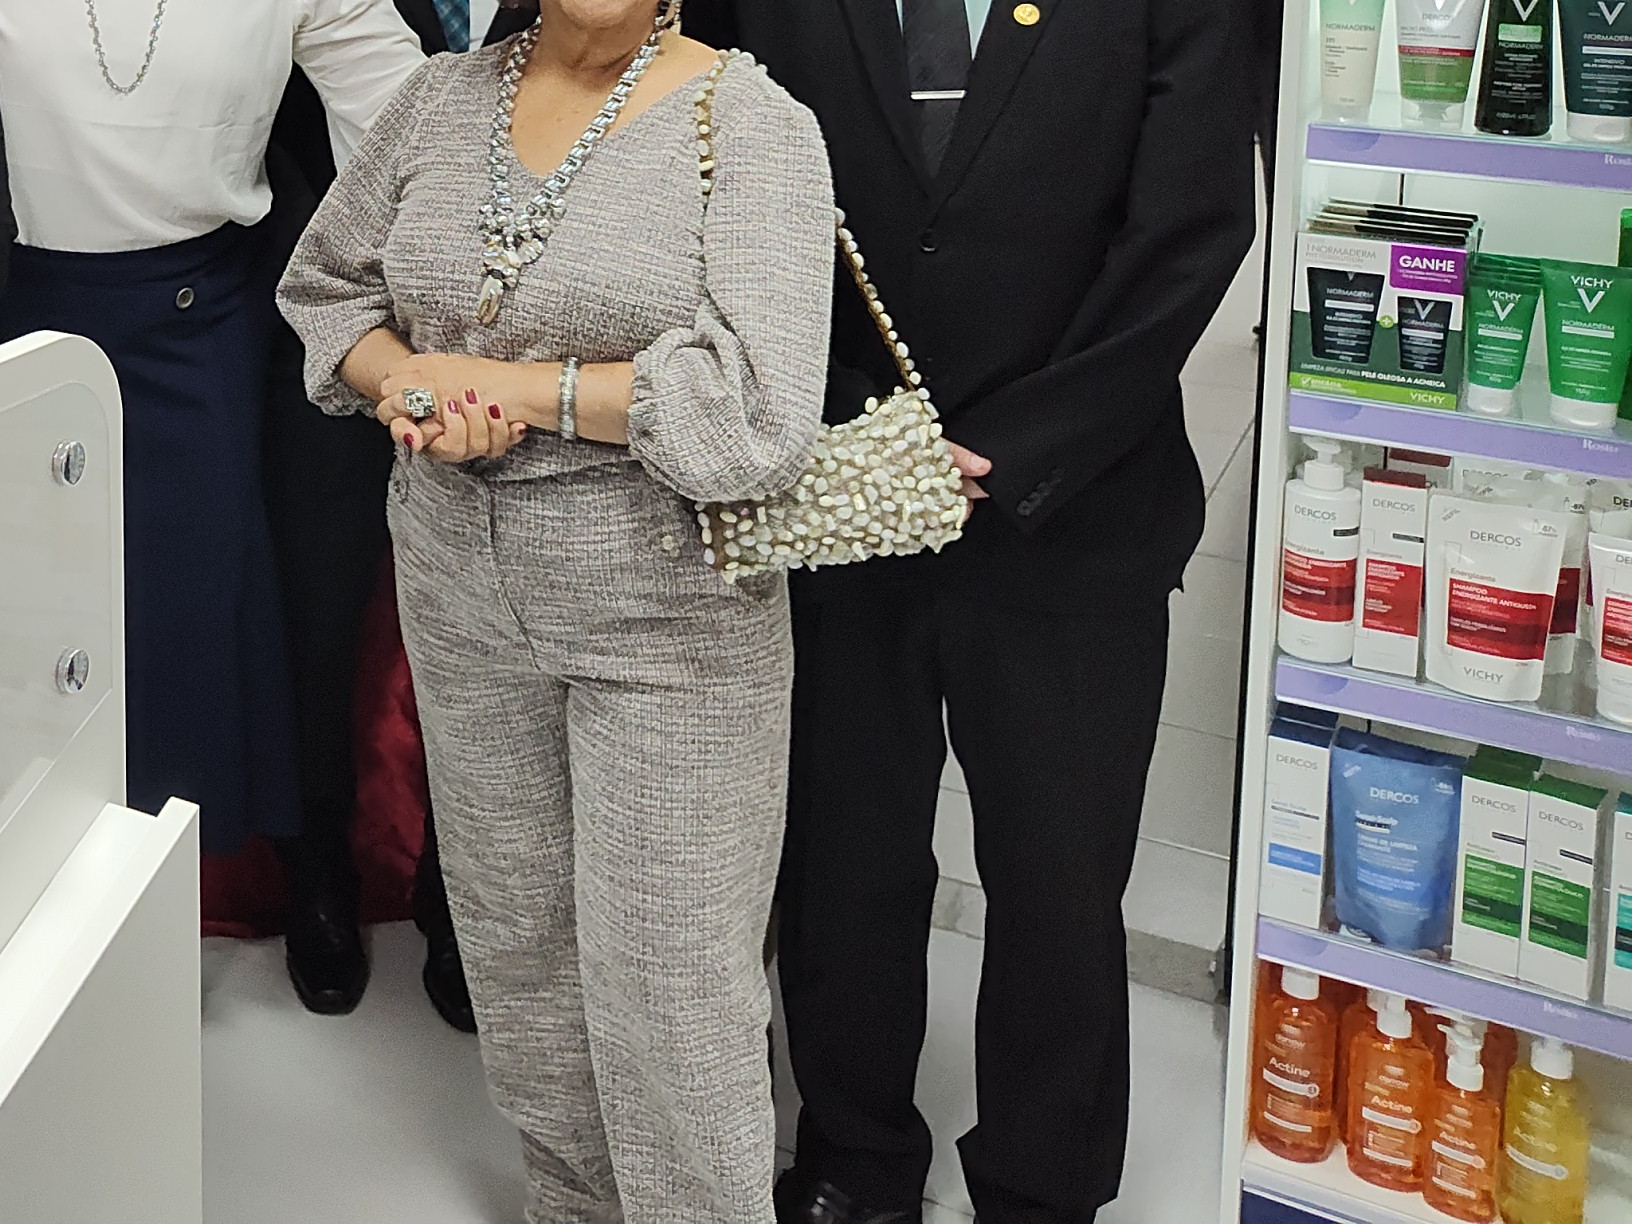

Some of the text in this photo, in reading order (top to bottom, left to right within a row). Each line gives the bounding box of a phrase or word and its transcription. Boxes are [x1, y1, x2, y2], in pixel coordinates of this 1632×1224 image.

[1326, 23, 1375, 31] NORMADERM
[1316, 244, 1377, 259] NORMADERM
[1399, 256, 1455, 272] GANHE
[1571, 275, 1613, 289] VICHY
[1487, 289, 1521, 301] VICHY
[1411, 392, 1445, 405] VICHY
[1294, 504, 1337, 521] DERCOS
[1372, 498, 1416, 513] DERCOS
[1470, 530, 1522, 547] DERCOS
[1464, 666, 1504, 683] VICHY
[1276, 753, 1318, 770] DERCOS
[1370, 787, 1419, 804] DERCOS
[1471, 794, 1517, 813] DERCOS
[1538, 810, 1584, 831] DERCOS
[1269, 1056, 1311, 1077] Actine
[1371, 1095, 1413, 1114] Actine
[1439, 1131, 1477, 1150] Actine
